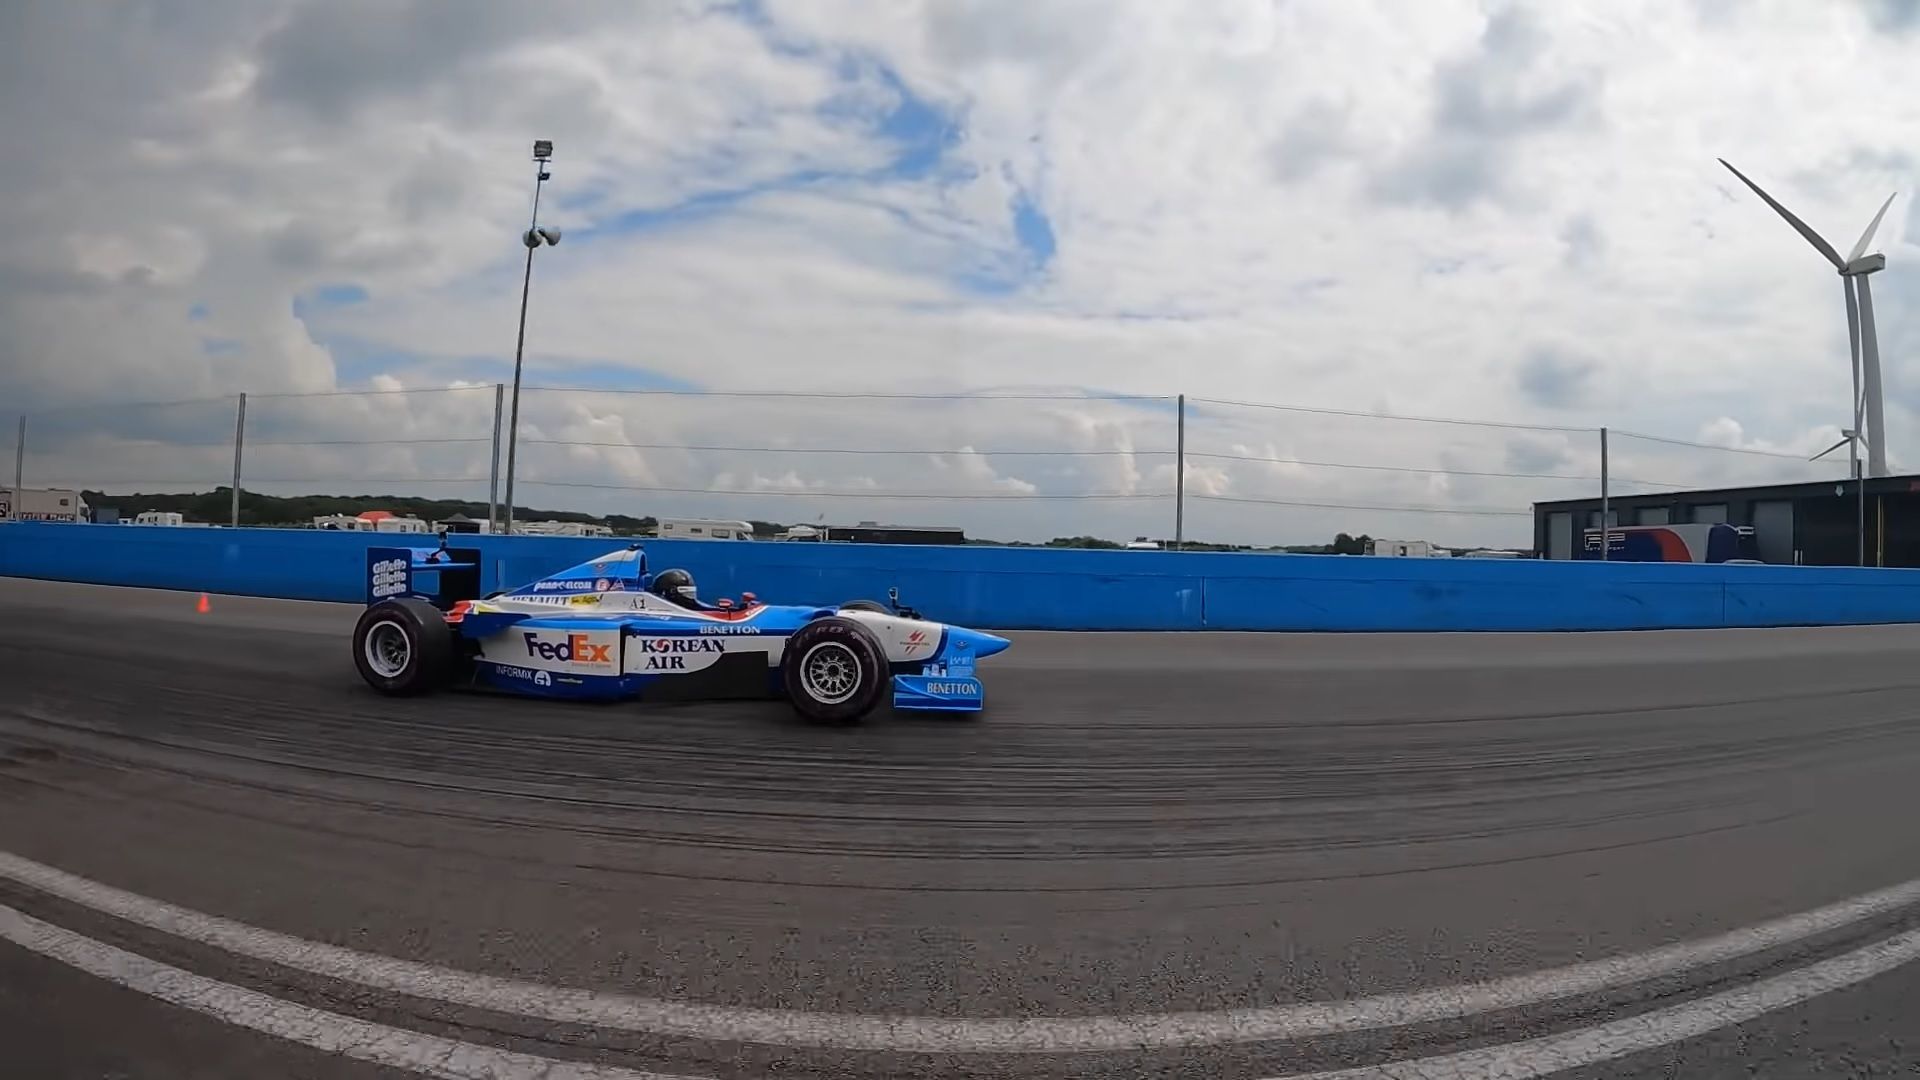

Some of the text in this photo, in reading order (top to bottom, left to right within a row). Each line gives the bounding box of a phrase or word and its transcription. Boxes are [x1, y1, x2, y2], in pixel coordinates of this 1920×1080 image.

[700, 626, 760, 634] BENETTON
[523, 632, 611, 662] FedEx
[641, 639, 725, 653] KOREAN
[645, 656, 686, 670] AIR
[927, 682, 977, 694] BENETTON
